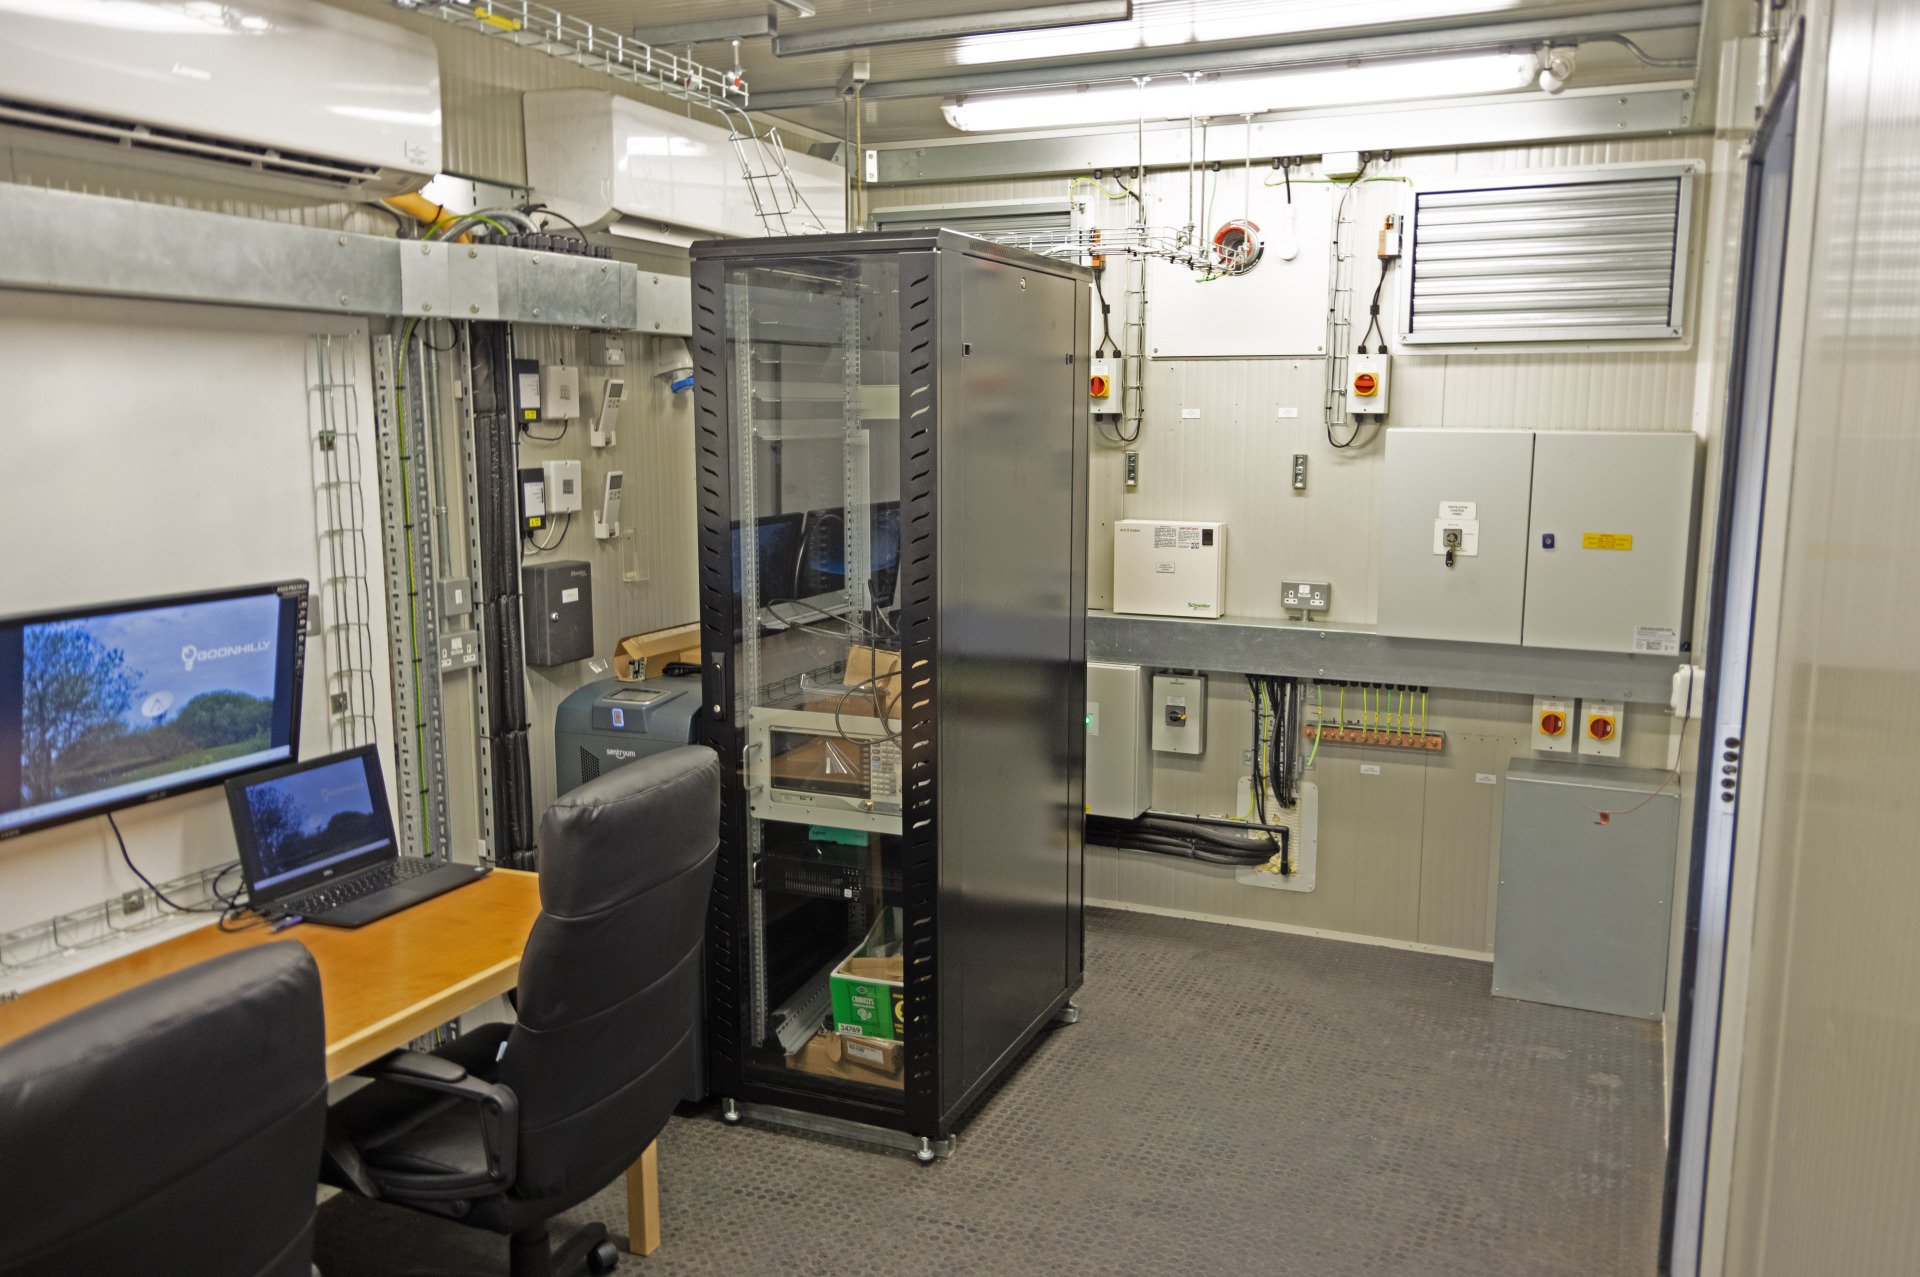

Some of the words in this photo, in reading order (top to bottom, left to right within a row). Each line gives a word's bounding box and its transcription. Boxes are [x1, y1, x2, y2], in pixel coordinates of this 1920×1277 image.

[1188, 602, 1211, 610] Schneider
[197, 640, 270, 661] GOONHILLY
[606, 748, 636, 760] sentryum
